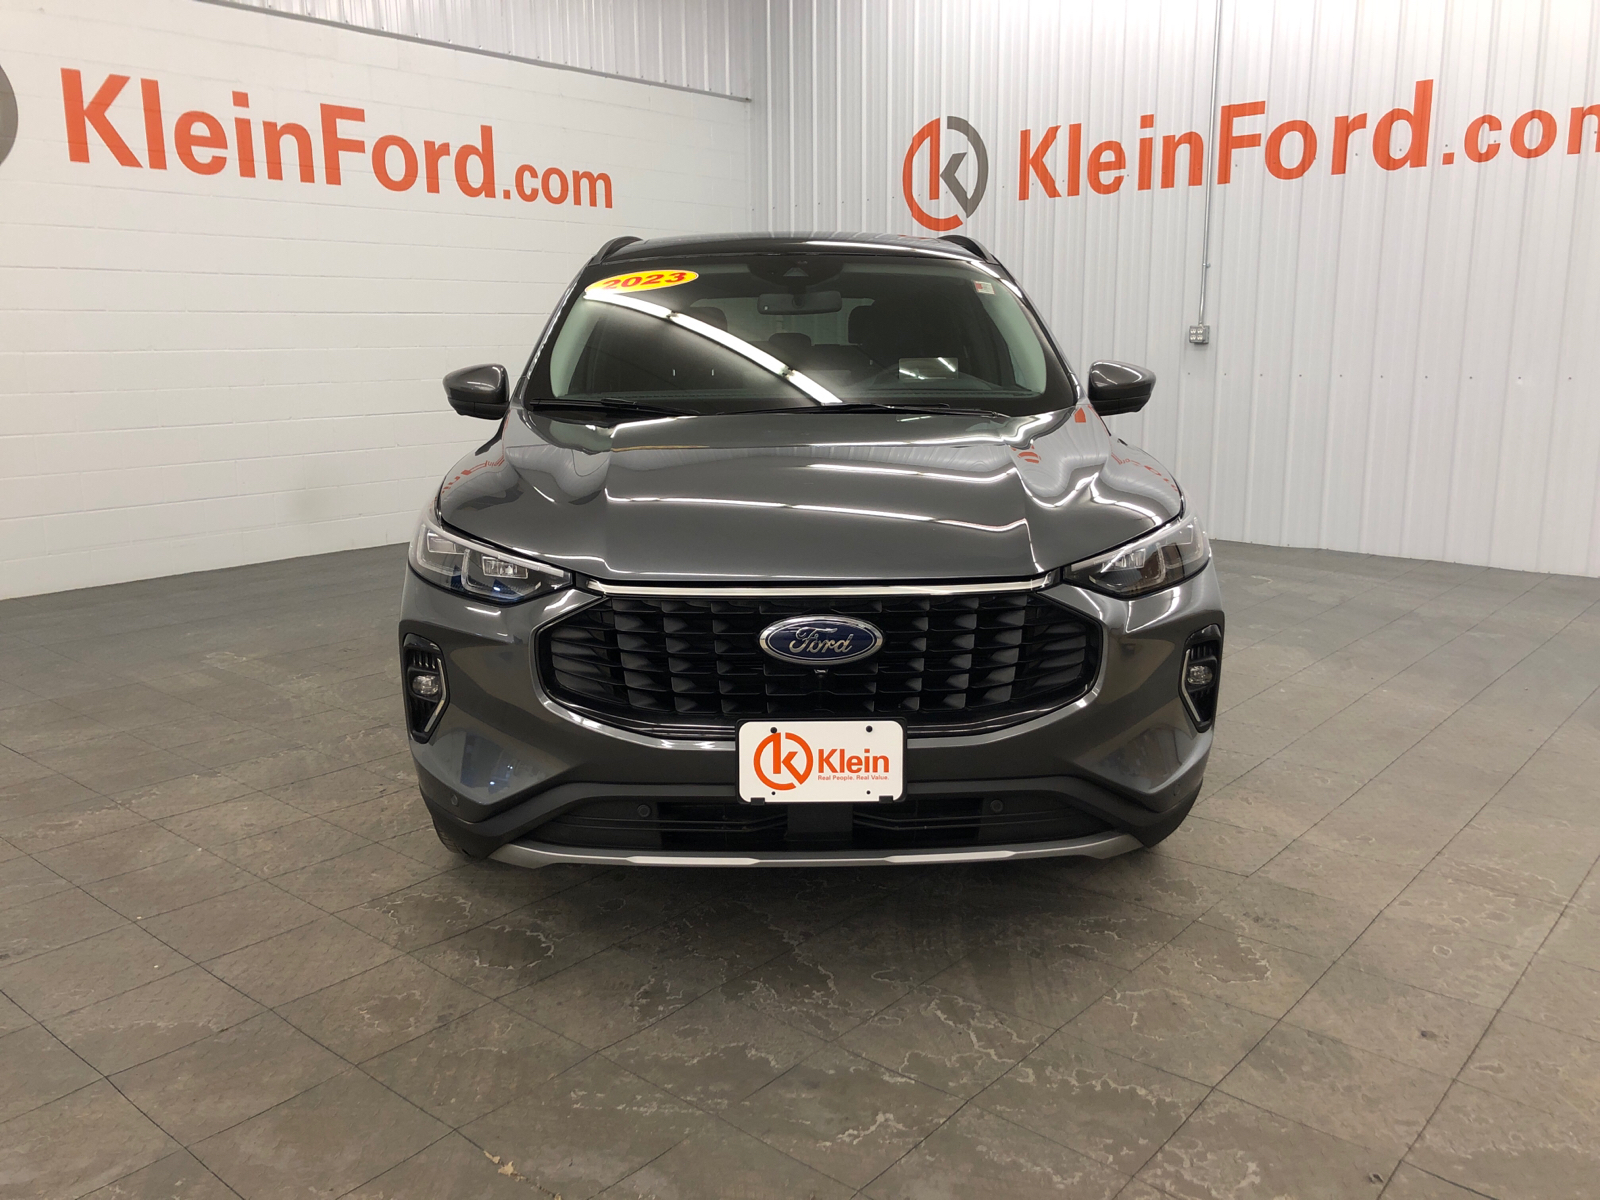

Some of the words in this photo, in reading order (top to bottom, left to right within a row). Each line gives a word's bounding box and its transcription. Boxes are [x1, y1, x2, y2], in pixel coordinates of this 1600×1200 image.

[60, 68, 613, 208] KleinFord.com
[602, 272, 687, 290] 2023
[789, 626, 853, 653] Ford
[818, 748, 889, 773] Klein
[832, 774, 854, 782] People.
